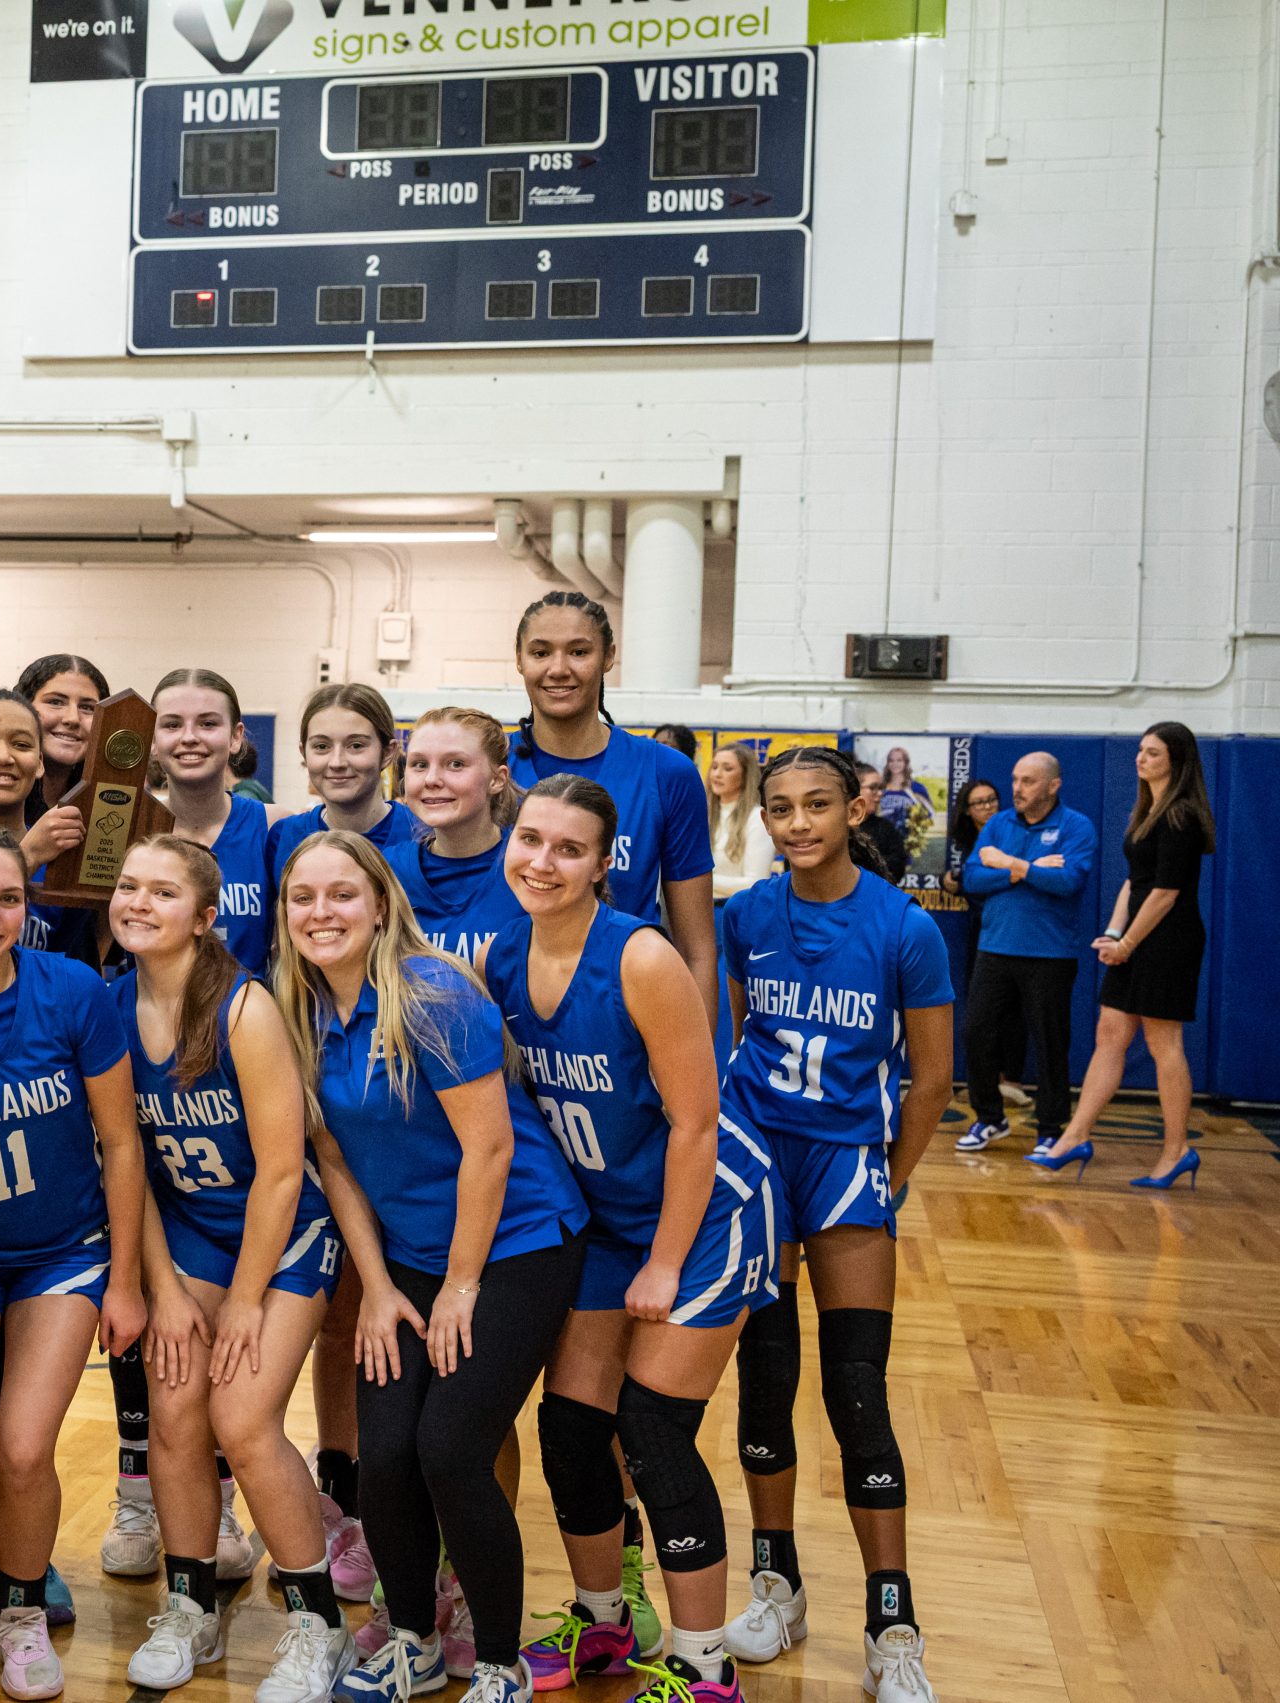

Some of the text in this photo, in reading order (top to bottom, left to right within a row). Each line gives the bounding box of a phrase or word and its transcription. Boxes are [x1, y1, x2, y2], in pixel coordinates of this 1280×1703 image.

[43, 16, 135, 38] we're on it.
[313, 28, 408, 64] signs
[420, 24, 443, 52] &
[456, 19, 596, 51] custom
[608, 6, 769, 48] apparel
[634, 61, 779, 102] VISITOR
[183, 86, 281, 123] HOME
[350, 161, 392, 179] POSS
[529, 153, 573, 171] POSS
[398, 182, 479, 207] PERIOD
[647, 188, 725, 213] BONUS
[209, 204, 279, 228] BONUS
[366, 256, 380, 277] 2
[537, 251, 551, 273] 3
[694, 246, 709, 267] 4
[218, 260, 229, 281] 1
[86, 854, 119, 864] BASKETBALL
[97, 847, 112, 855] GIRLS
[86, 872, 114, 880] CHAMPION
[89, 864, 114, 872] DISTRICT
[747, 976, 876, 1030] HIGHLANDS
[768, 1028, 828, 1101] 31
[135, 1089, 239, 1127] GHLANDS
[155, 1135, 235, 1193] 23
[319, 1236, 340, 1276] H
[742, 1254, 764, 1296] H
